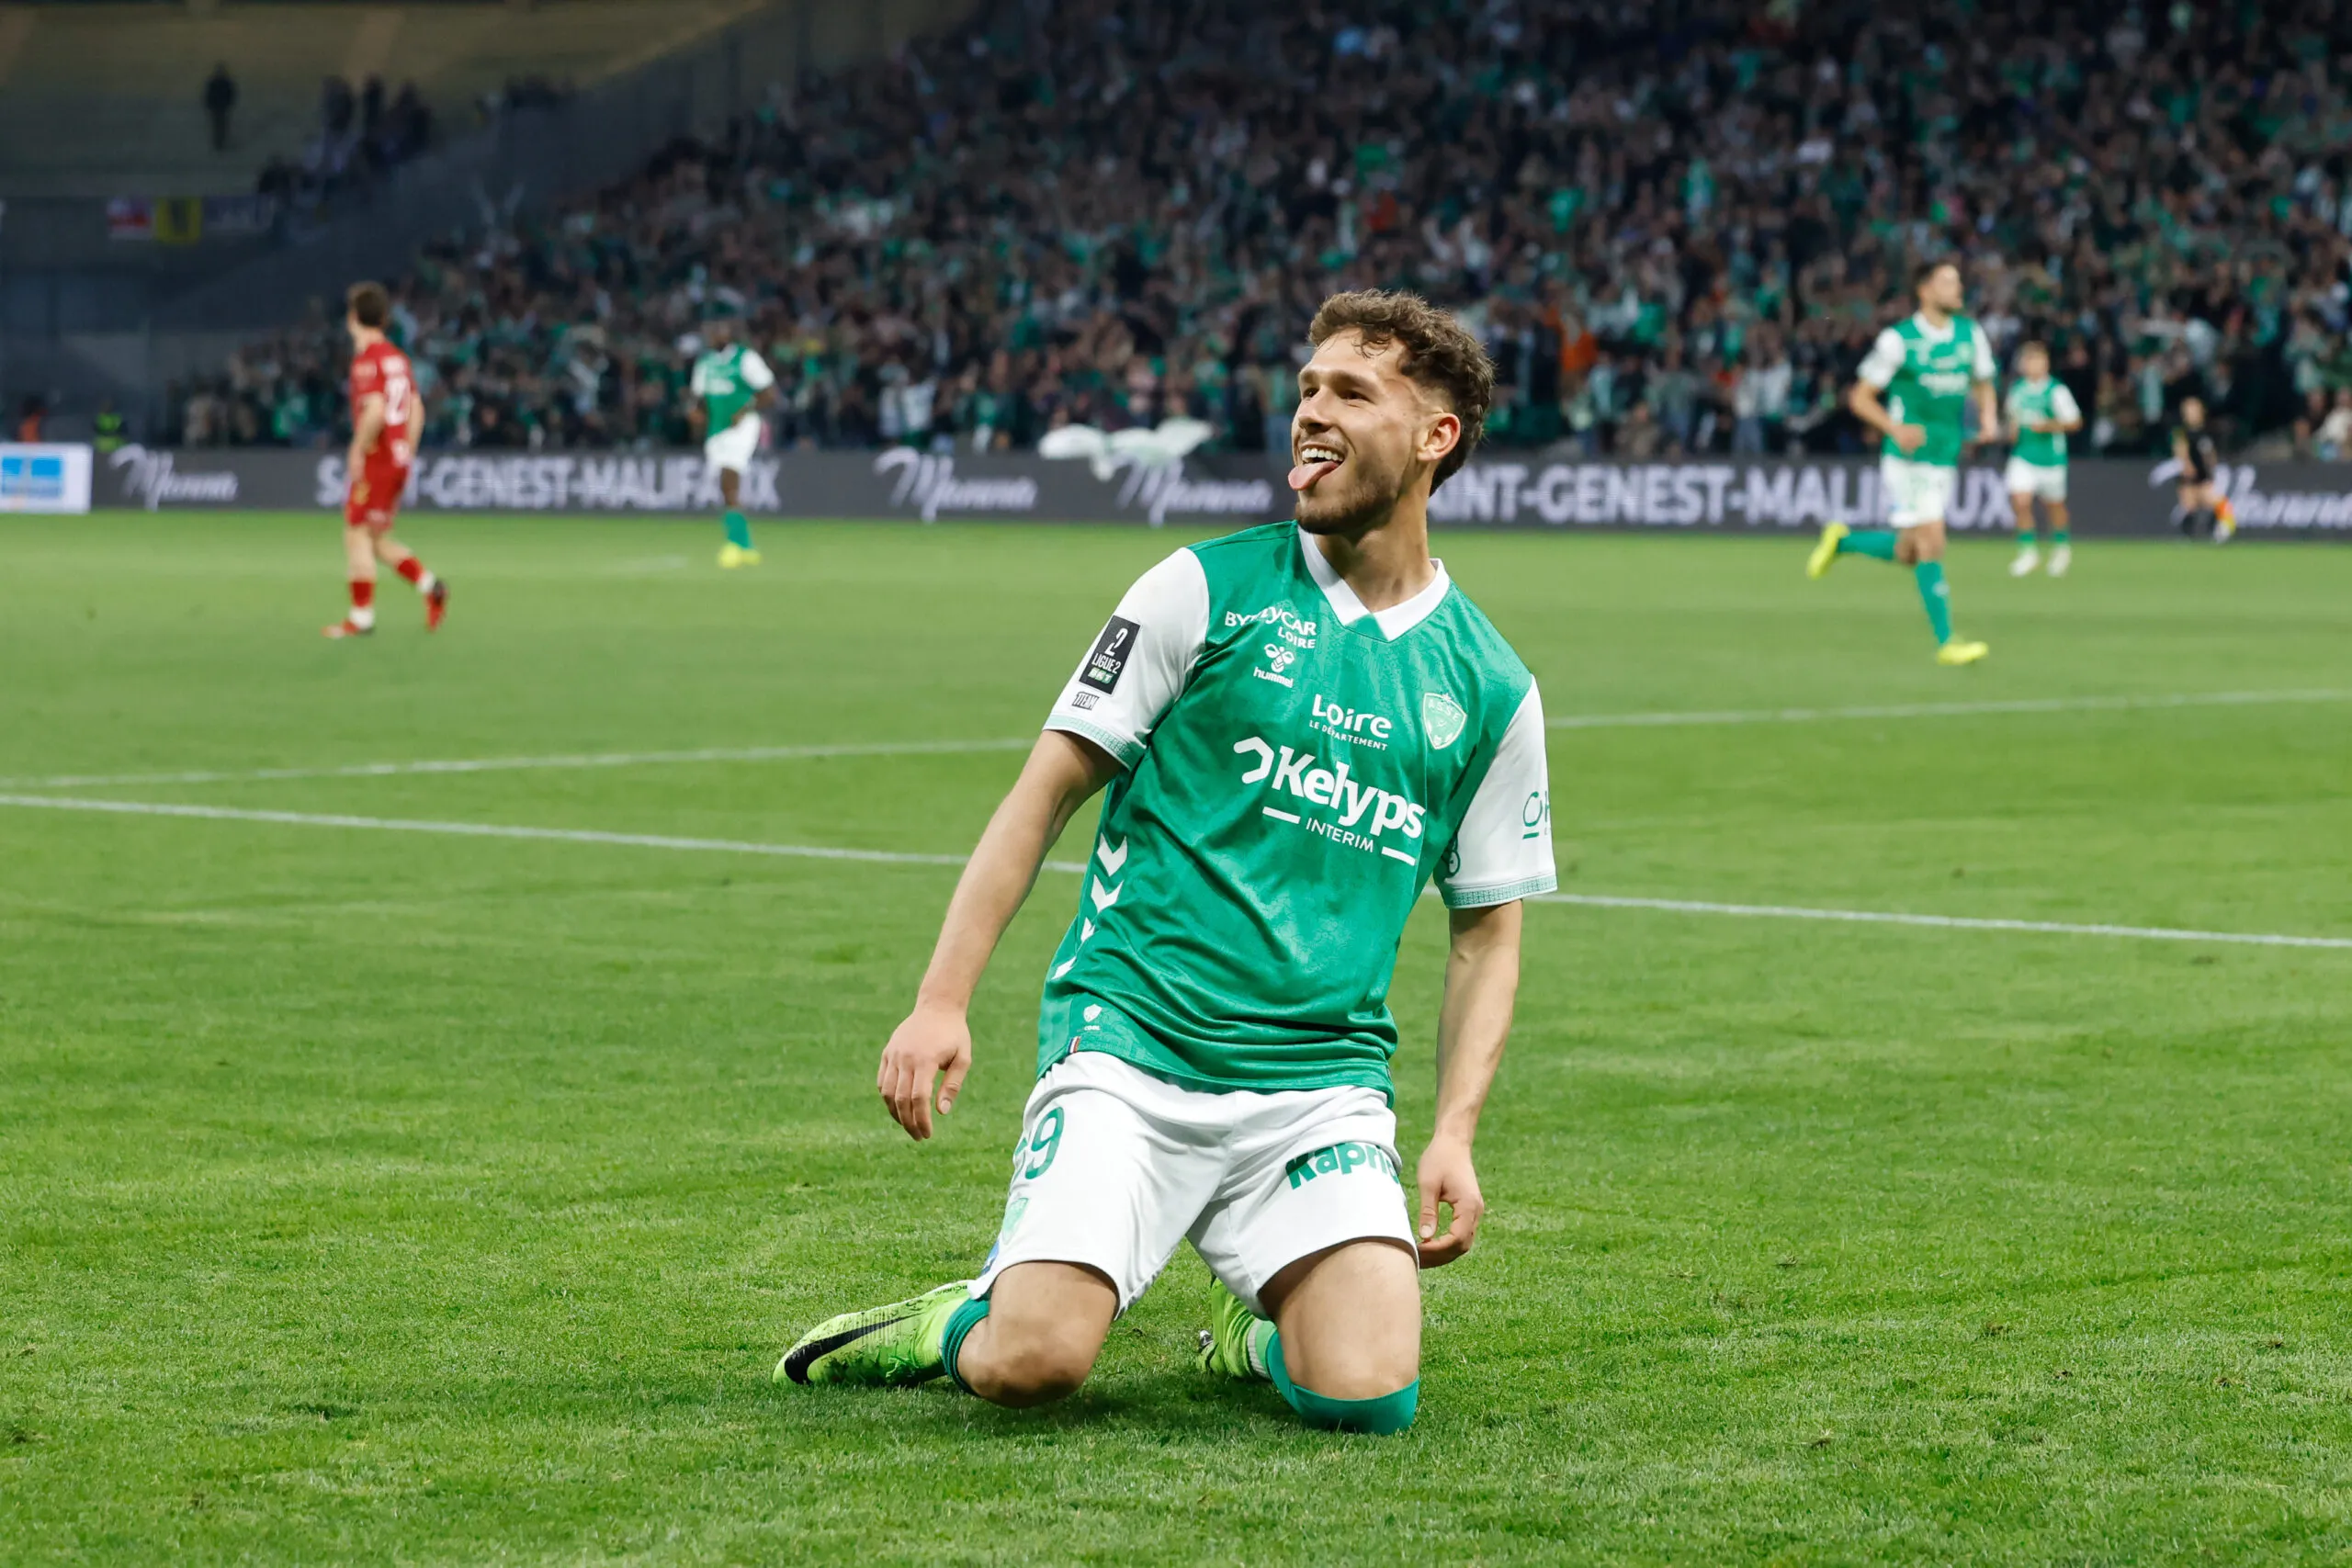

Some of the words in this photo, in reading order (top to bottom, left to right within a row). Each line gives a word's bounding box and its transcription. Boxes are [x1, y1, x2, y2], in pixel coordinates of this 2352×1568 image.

[1103, 627, 1128, 657] 2
[1277, 626, 1317, 649] LOIRE
[1253, 666, 1295, 689] hummel
[1308, 719, 1320, 729] LE
[1312, 694, 1392, 739] Loire
[1271, 745, 1427, 839] Kelyps
[1306, 817, 1374, 853] INTERIM
